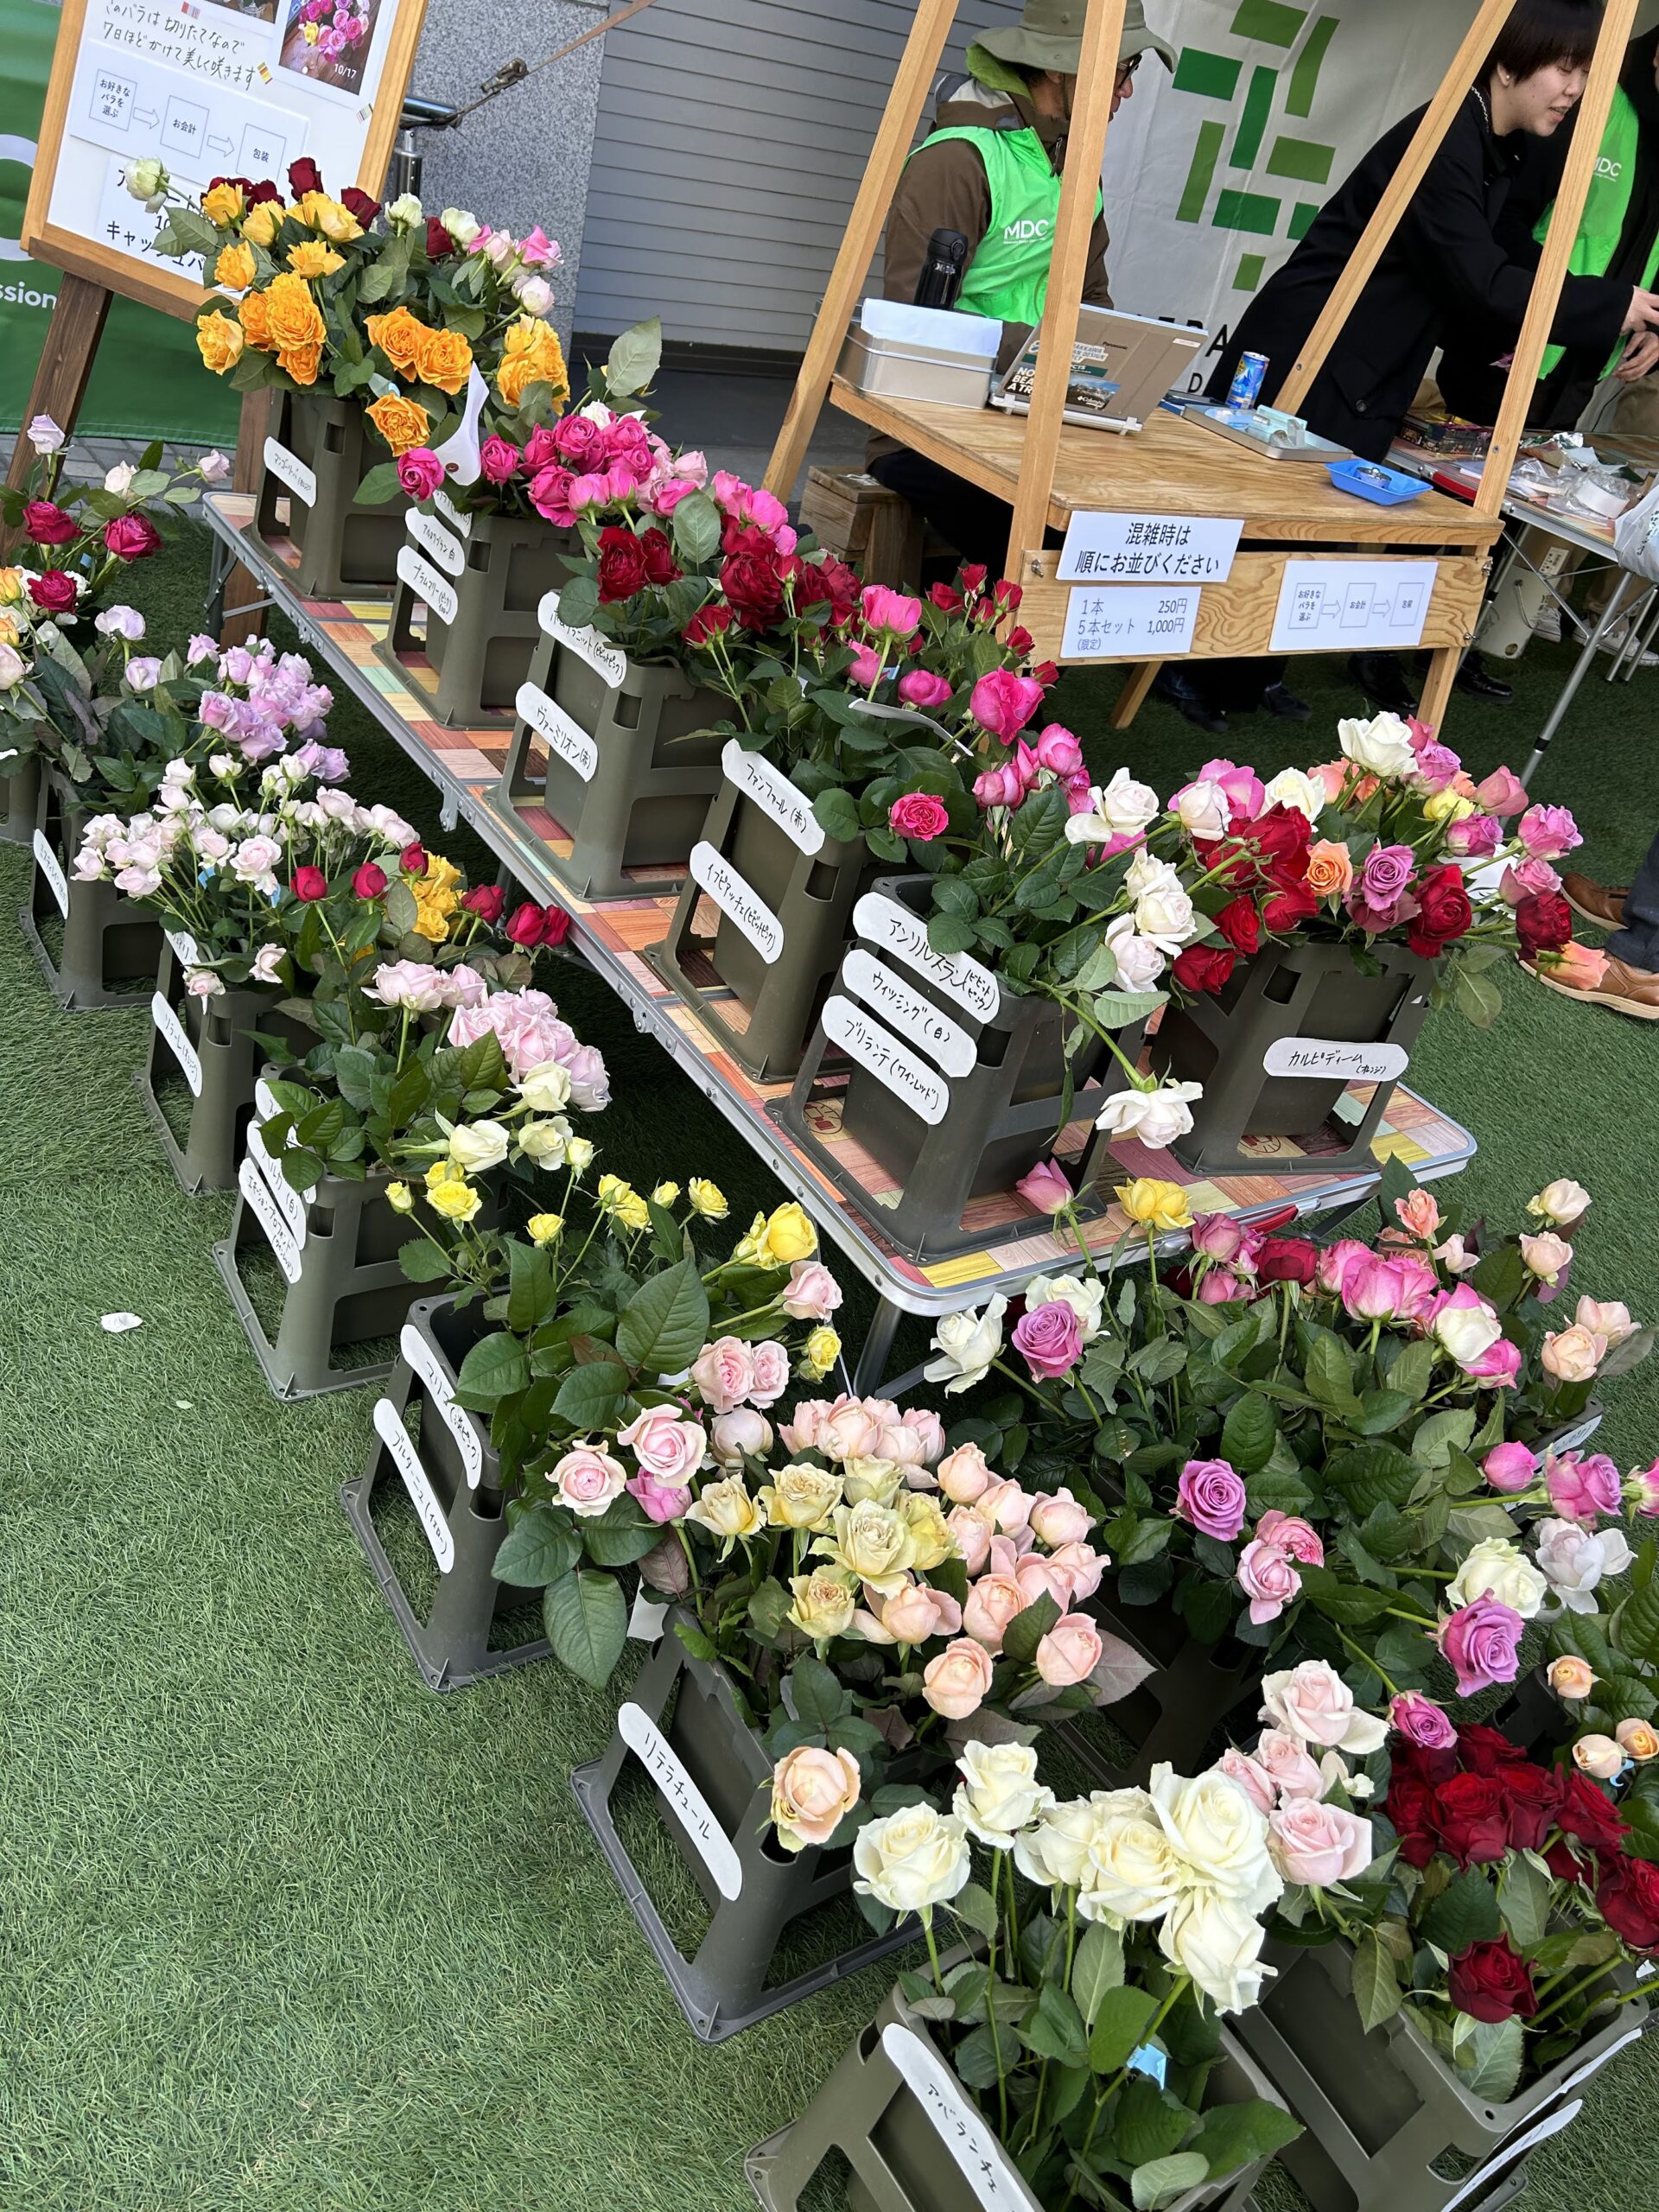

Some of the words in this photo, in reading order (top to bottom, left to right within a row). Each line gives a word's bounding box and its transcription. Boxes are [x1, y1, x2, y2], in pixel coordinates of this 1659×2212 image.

[104, 21, 256, 91] 7日ほどかけて美しく咲きます
[334, 63, 358, 79] 10/17
[99, 79, 131, 98] お好きな
[101, 92, 124, 108] バラを
[102, 105, 119, 118] 選ぶ
[173, 118, 197, 136] お会計
[253, 148, 270, 163] 包装
[1593, 156, 1622, 177] DC
[1003, 219, 1049, 239] MDC
[106, 220, 206, 271] キャッュバ
[1125, 522, 1192, 546] 混雑時は
[1075, 550, 1219, 575] 順にお並びください
[1081, 598, 1104, 615] 1本
[1158, 598, 1188, 614] 250円
[1077, 618, 1135, 636] 5本セット
[1147, 617, 1185, 636] 1,000円
[1077, 639, 1102, 652] (限定)
